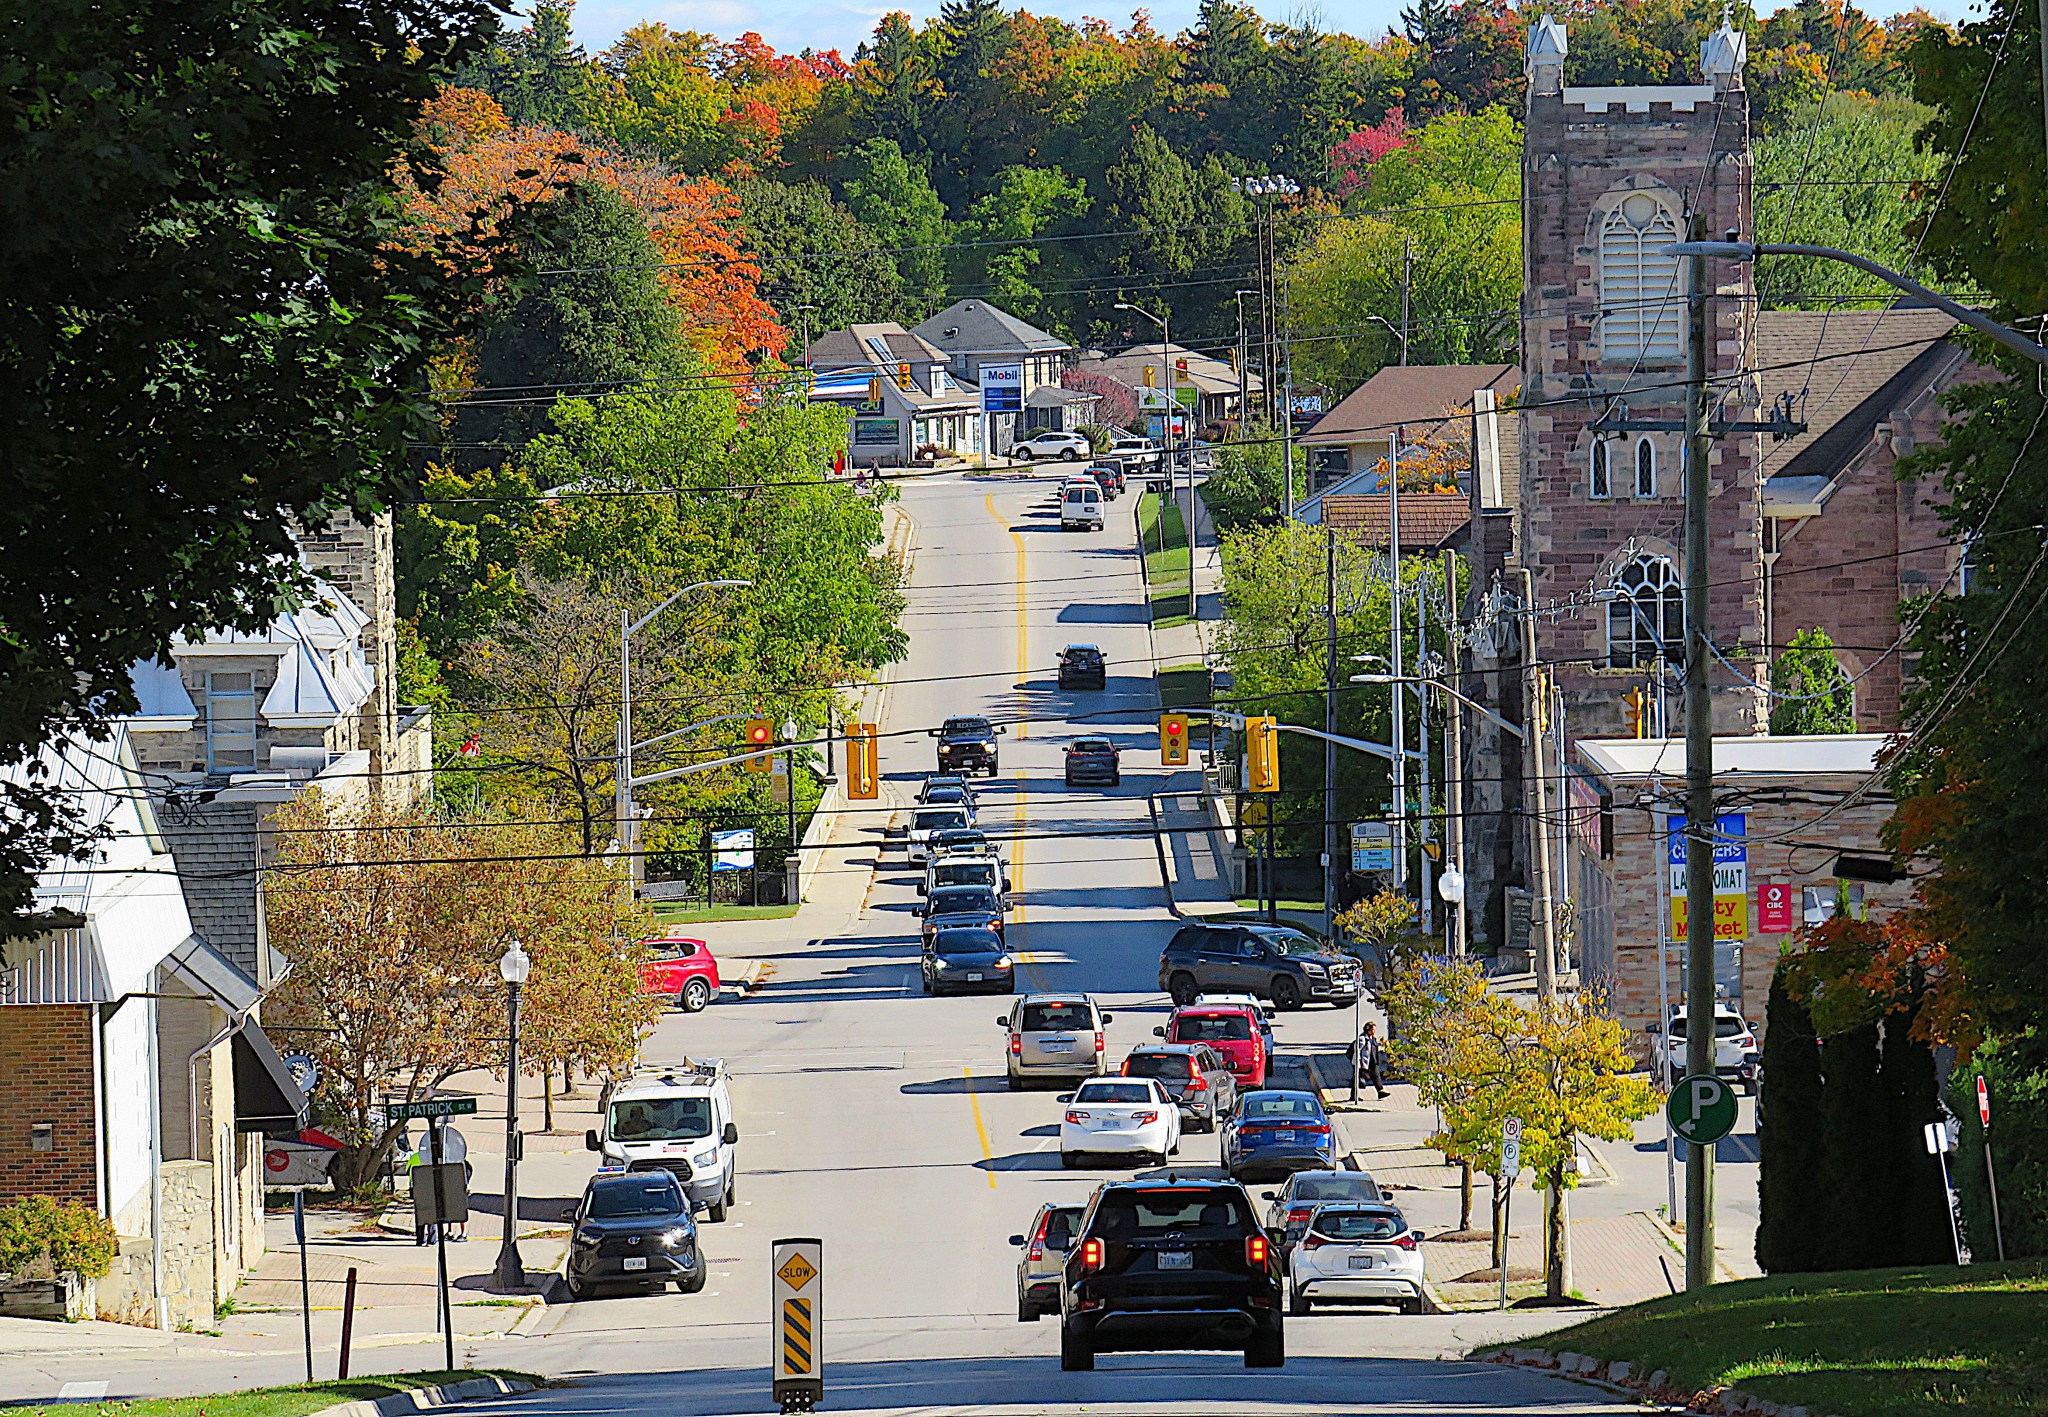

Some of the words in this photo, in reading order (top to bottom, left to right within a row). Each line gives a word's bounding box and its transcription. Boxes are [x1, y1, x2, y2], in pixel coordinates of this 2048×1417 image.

[988, 370, 1018, 380] Mobil
[1672, 844, 1741, 859] CLERS
[1673, 869, 1743, 890] LAOMAT
[1766, 901, 1784, 909] CIBC
[1676, 920, 1743, 937] Mket
[1691, 1080, 1722, 1120] P
[390, 1105, 406, 1118] ST.
[408, 1102, 454, 1117] PATRICK
[783, 1267, 811, 1278] SLOW
